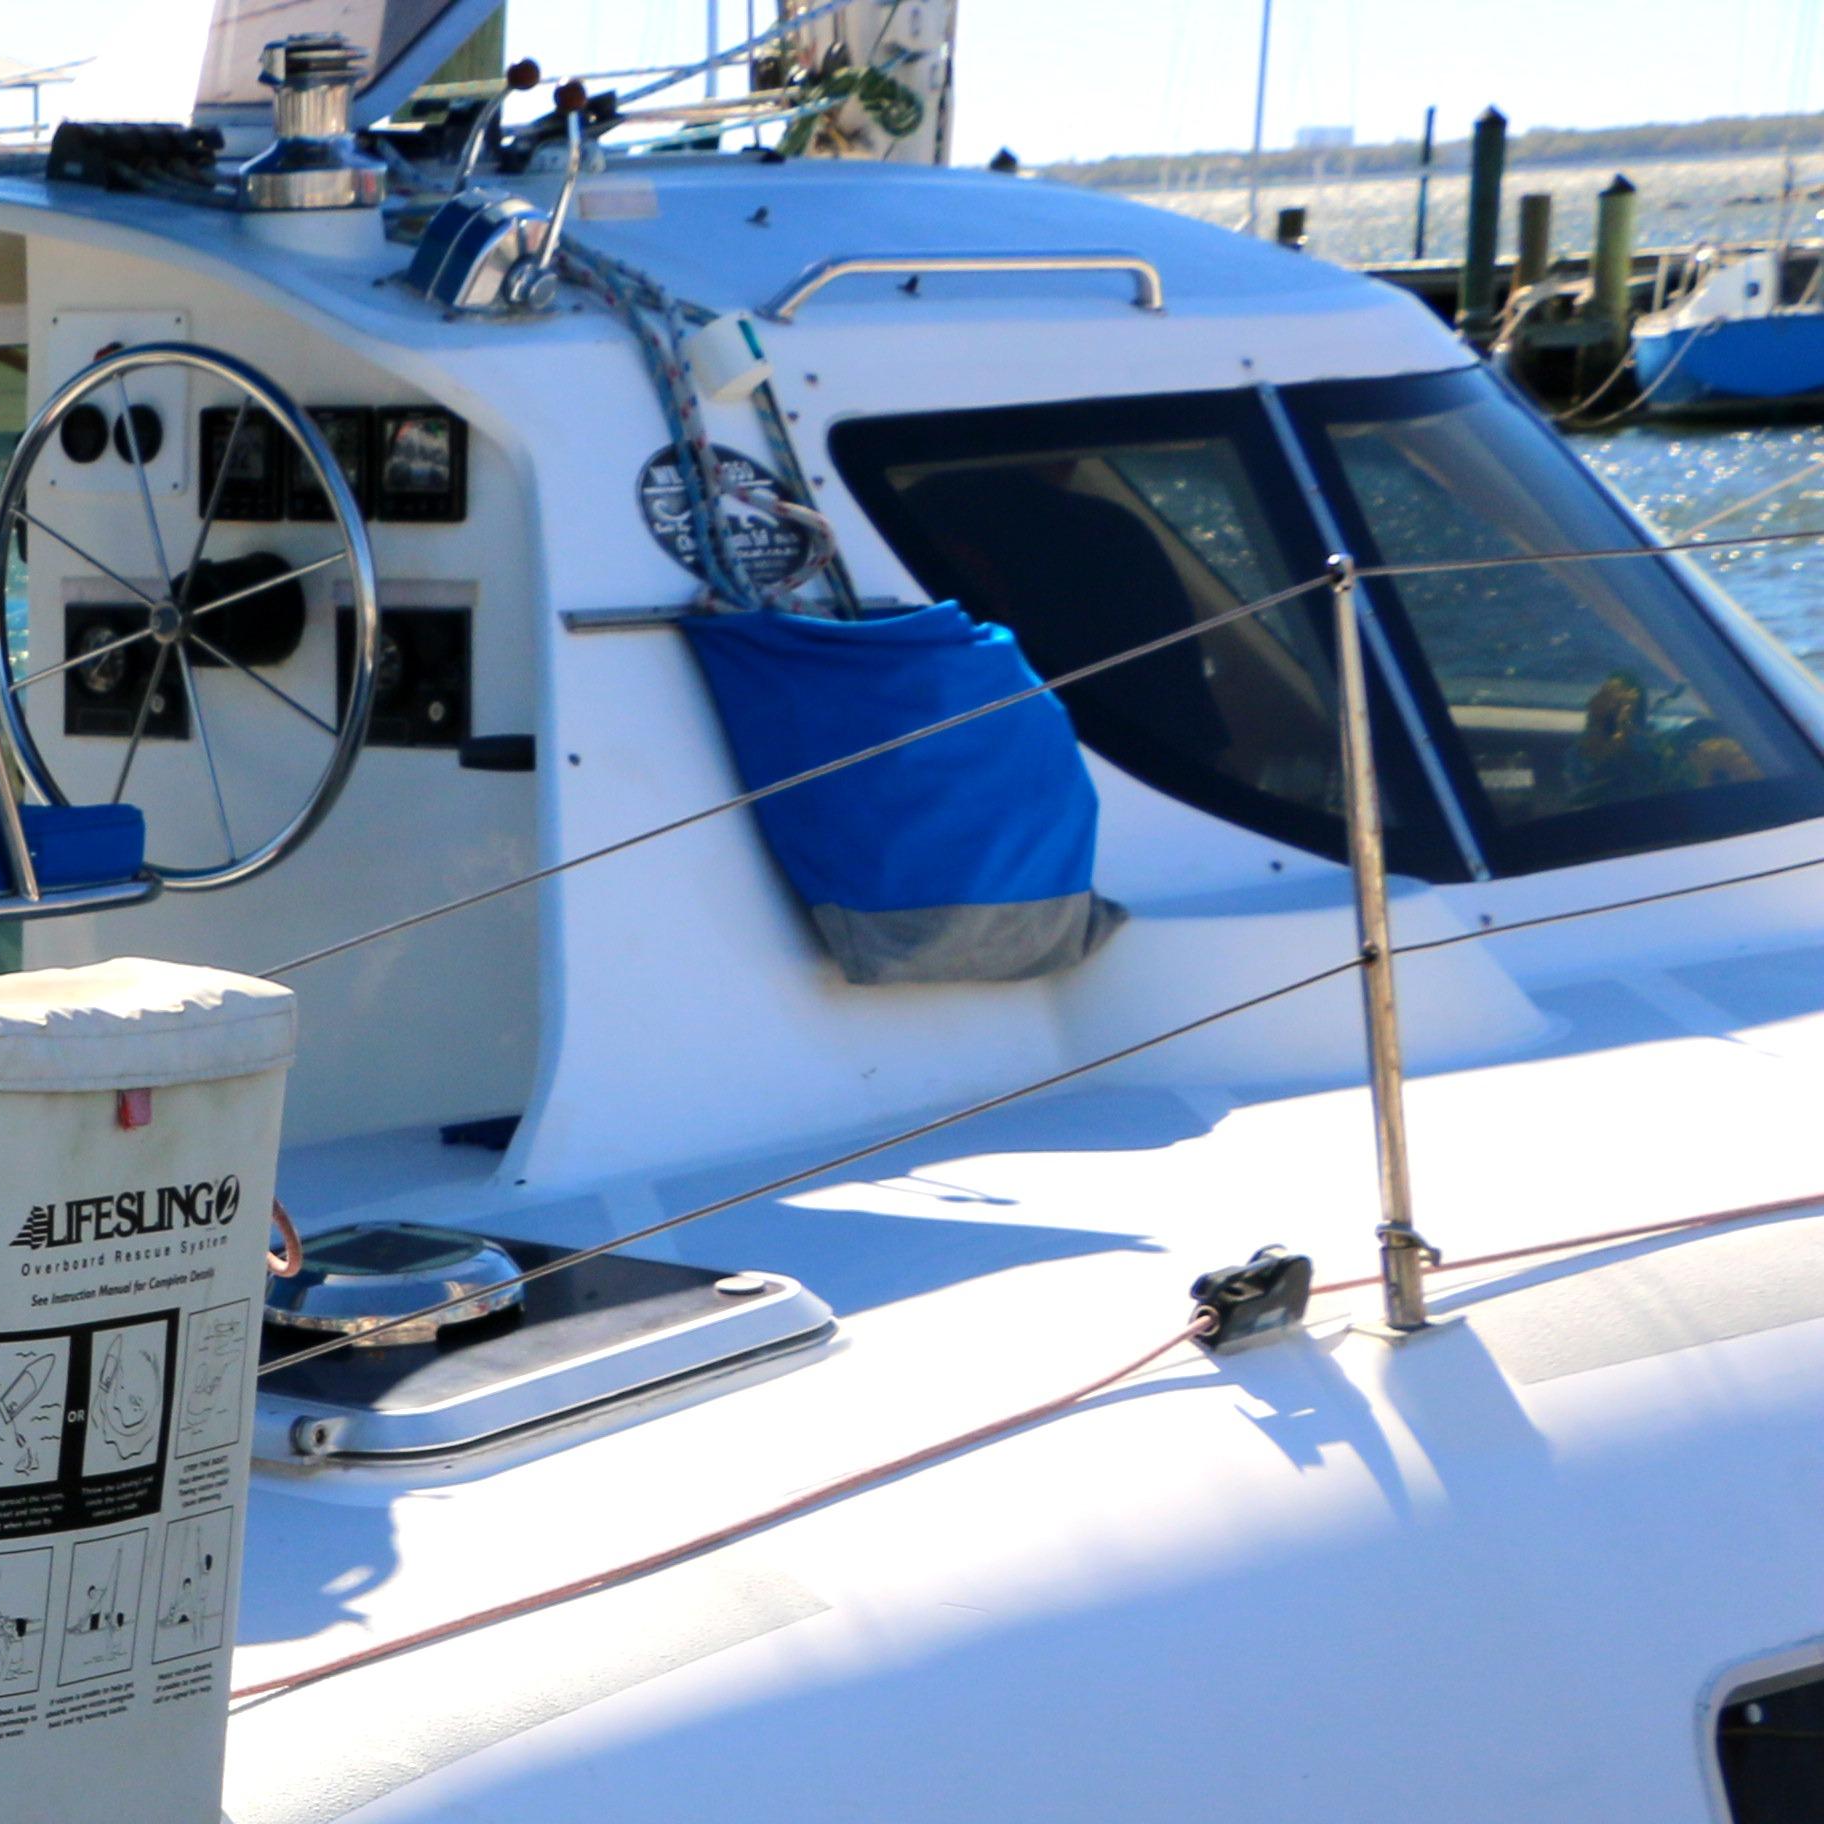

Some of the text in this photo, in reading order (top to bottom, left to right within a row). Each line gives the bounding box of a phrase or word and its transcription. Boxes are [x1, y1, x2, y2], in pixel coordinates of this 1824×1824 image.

[21, 1234, 228, 1277] Overboard Rescue System
[30, 1293, 48, 1307] See
[51, 1288, 97, 1305] Instruction
[98, 1281, 132, 1298] Manual
[133, 1280, 146, 1296] for
[149, 1274, 188, 1291] Complete
[67, 1409, 85, 1423] OR
